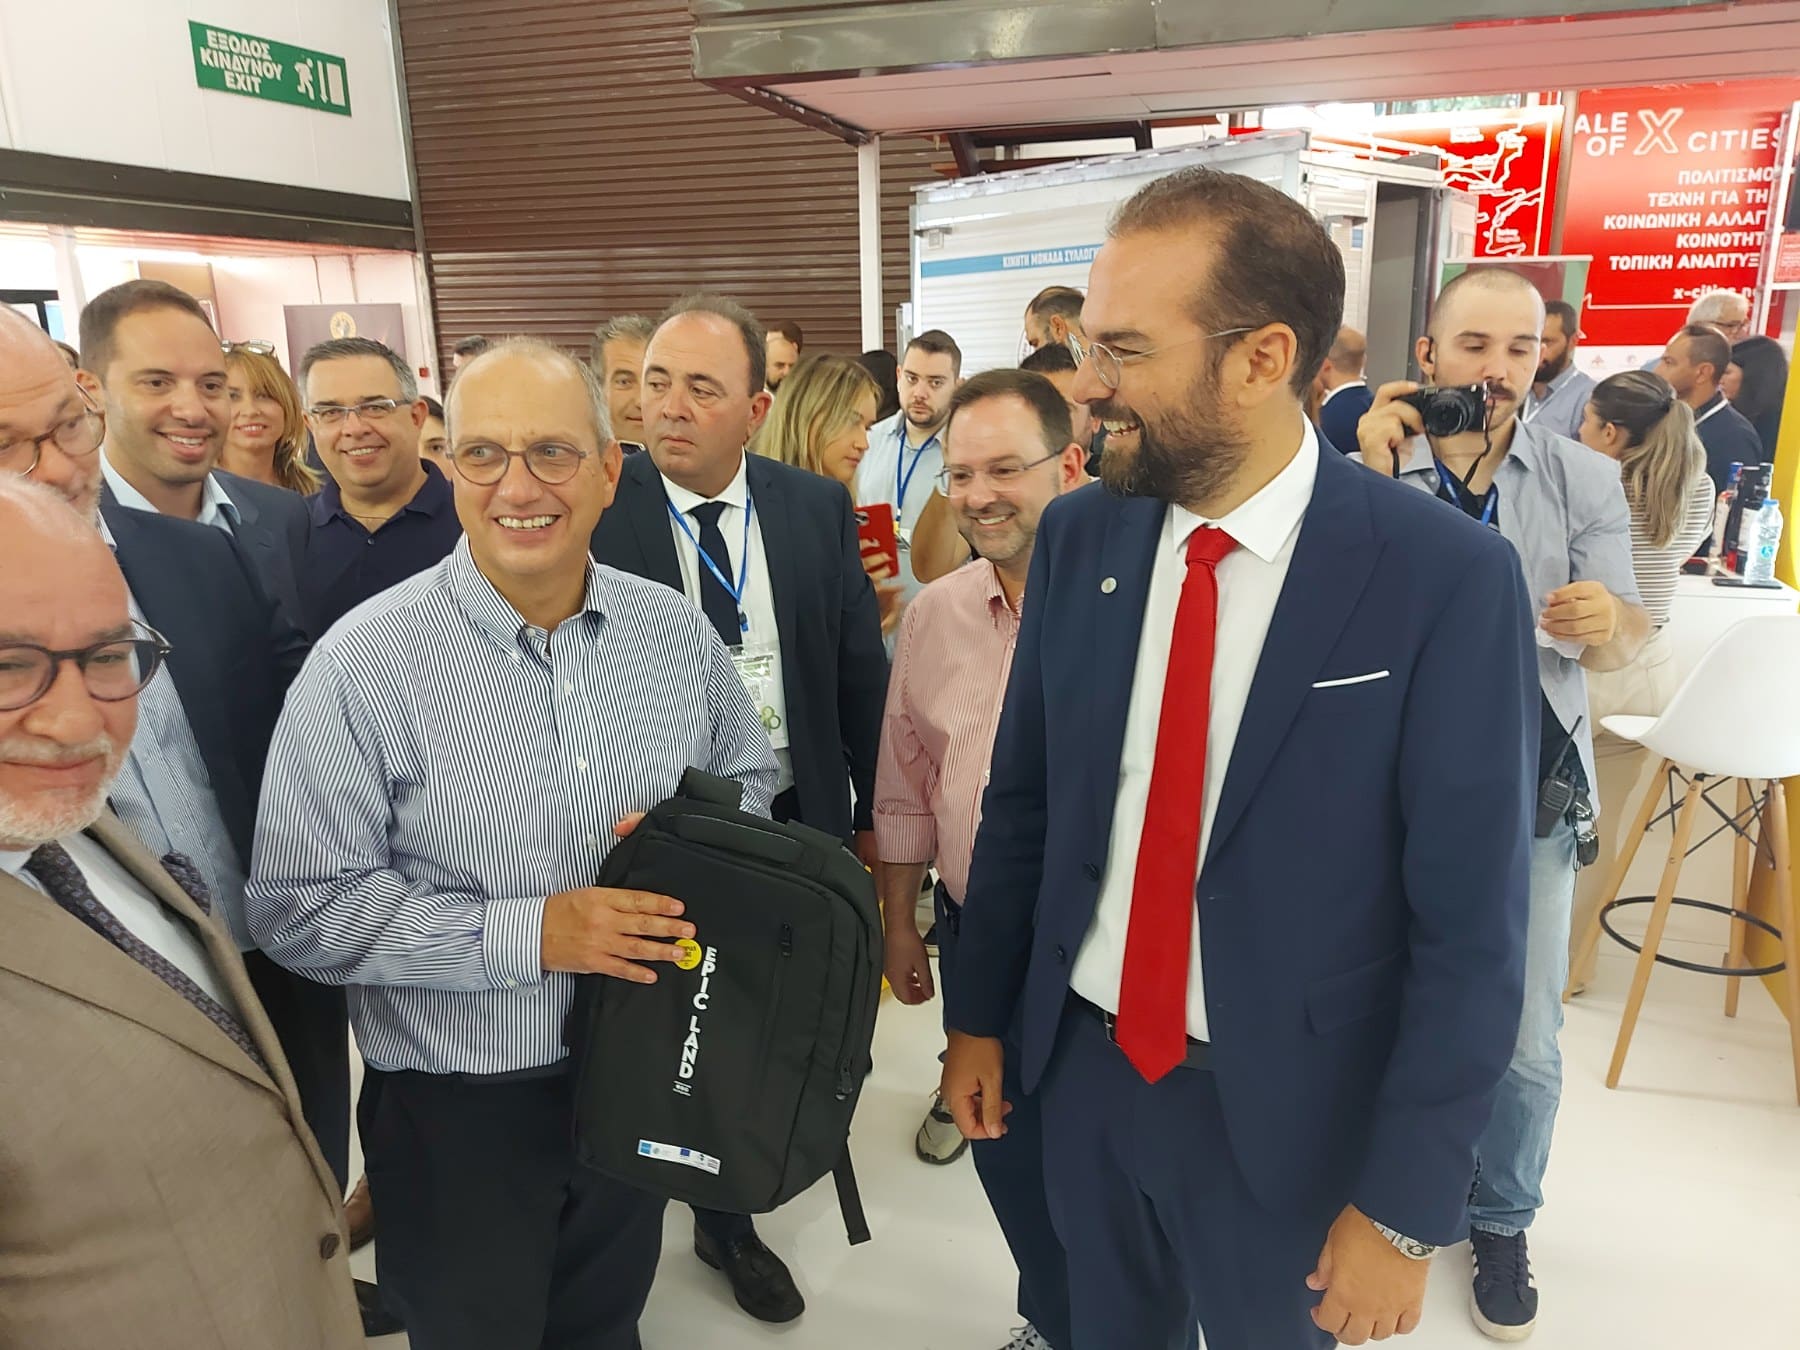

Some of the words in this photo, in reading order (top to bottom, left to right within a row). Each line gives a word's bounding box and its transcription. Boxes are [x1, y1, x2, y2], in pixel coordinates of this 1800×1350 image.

[206, 29, 272, 60] ΕΞΟΔΟΣ
[200, 47, 282, 80] ΚΙΝΔΥΝΟΥ
[224, 70, 261, 93] EXIT
[1574, 112, 1628, 134] ALE
[1586, 136, 1626, 157] OF
[1633, 108, 1684, 155] X
[1678, 166, 1774, 185] ΠΟΛΙΤΙΣΜΟ
[1648, 192, 1704, 208] ΤΕΧΝΗ
[1710, 190, 1739, 206] ΓΙΑ
[1745, 188, 1768, 204] ΤΗ
[1603, 212, 1701, 230] ΚΟΙΝΩΝΙΚΗ
[1705, 210, 1767, 227] ΑΛΛΑΓ
[1609, 255, 1673, 270] ΤΟΠΙΚΗ
[1677, 253, 1760, 269] ΑΝΑΠΤΥΞ
[693, 946, 717, 1010] EPIC
[678, 1015, 700, 1079] LAND
